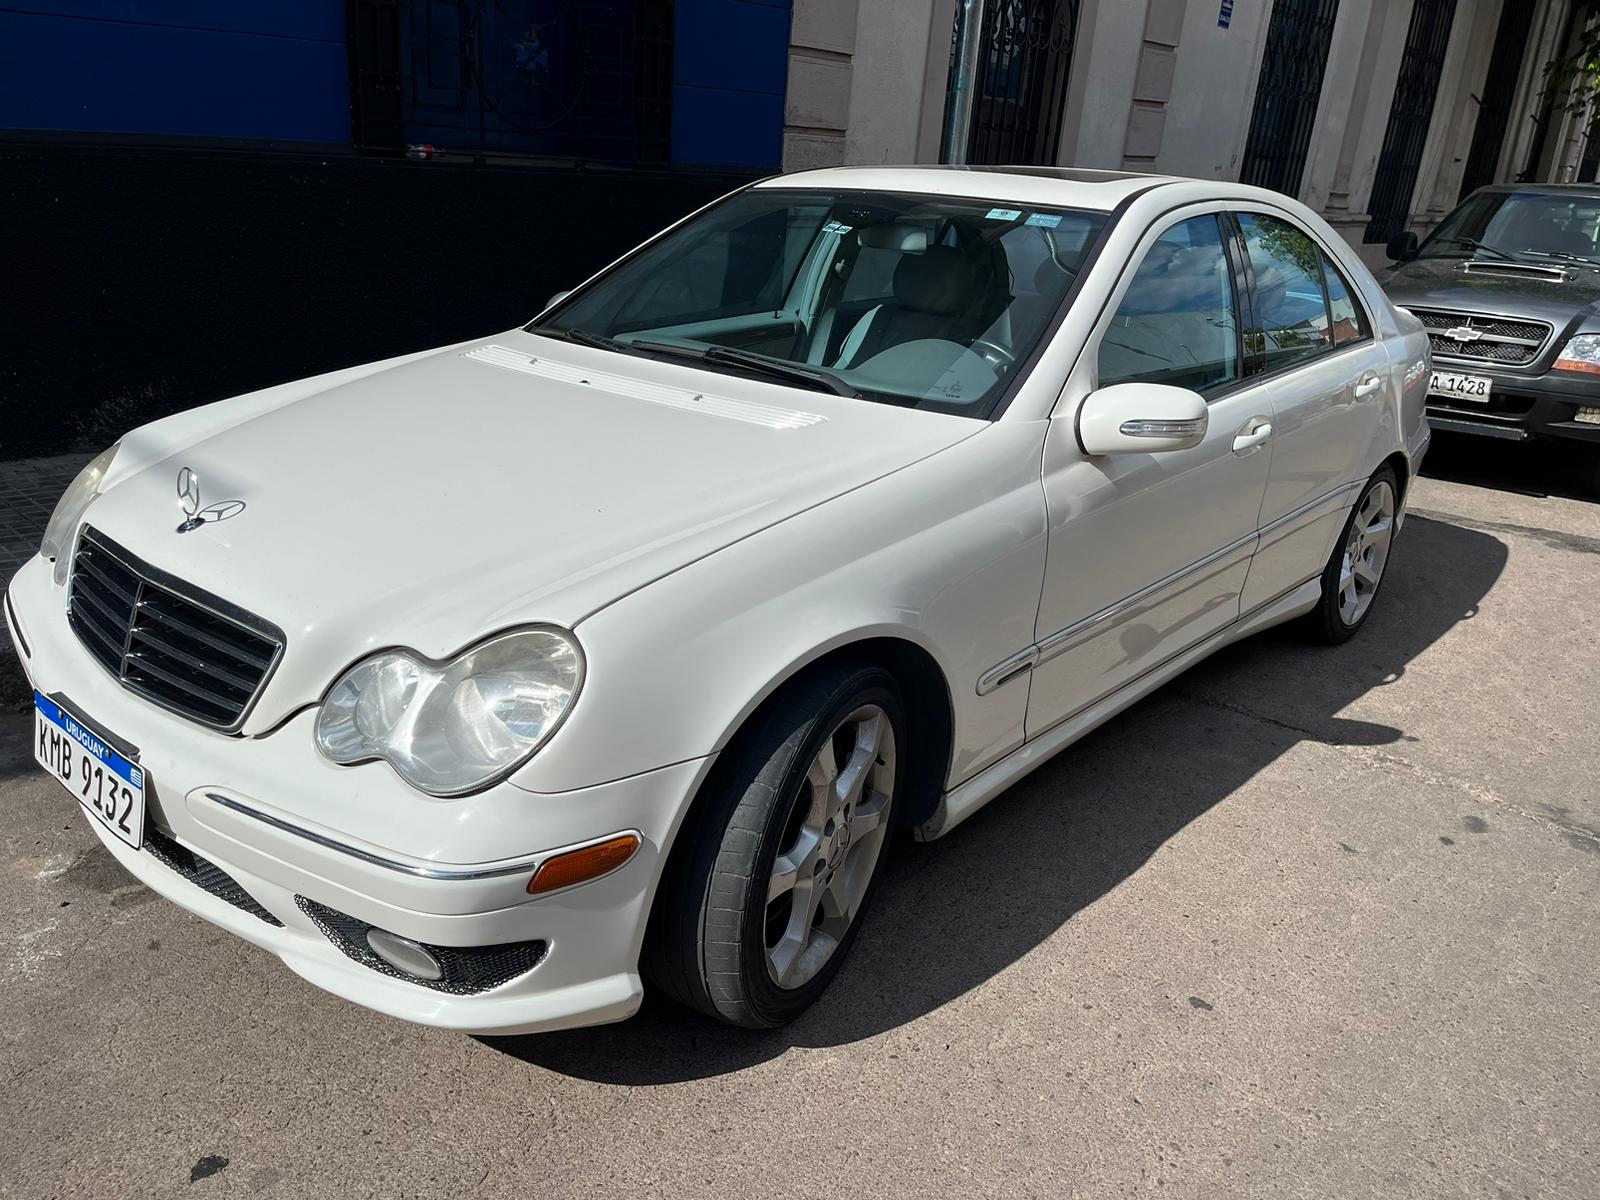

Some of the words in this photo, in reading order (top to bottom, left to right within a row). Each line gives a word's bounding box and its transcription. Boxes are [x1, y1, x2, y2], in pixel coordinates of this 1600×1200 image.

[1446, 377, 1486, 396] 1428
[65, 718, 105, 759] URUGUAY
[39, 718, 72, 781] KMB
[82, 755, 134, 834] 9132
